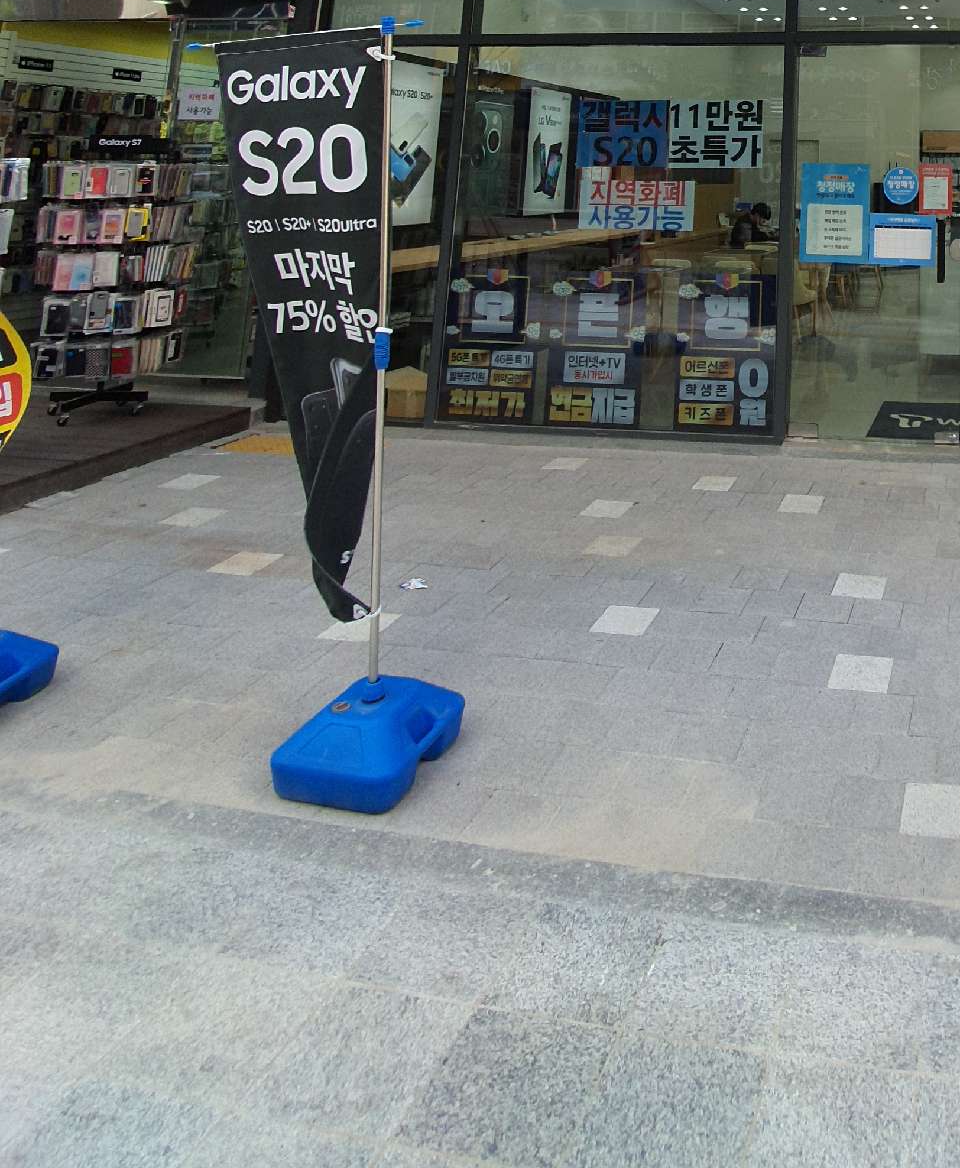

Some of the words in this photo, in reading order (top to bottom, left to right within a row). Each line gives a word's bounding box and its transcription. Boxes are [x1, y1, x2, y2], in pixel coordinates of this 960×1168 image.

[227, 65, 366, 108] Galaxy
[583, 100, 663, 132] 갤럭시
[670, 100, 763, 131] 11만원
[99, 138, 130, 149] Galaxy
[131, 138, 142, 146] S7
[593, 136, 657, 166] S20
[669, 135, 761, 167] 초특가
[238, 123, 368, 197] S20
[590, 180, 686, 207] 지역화폐
[247, 219, 273, 234] S20
[588, 205, 686, 232] 사용가능
[274, 248, 356, 295] 마지막
[267, 299, 337, 334] 75%
[568, 355, 621, 369] 인터넷+TV
